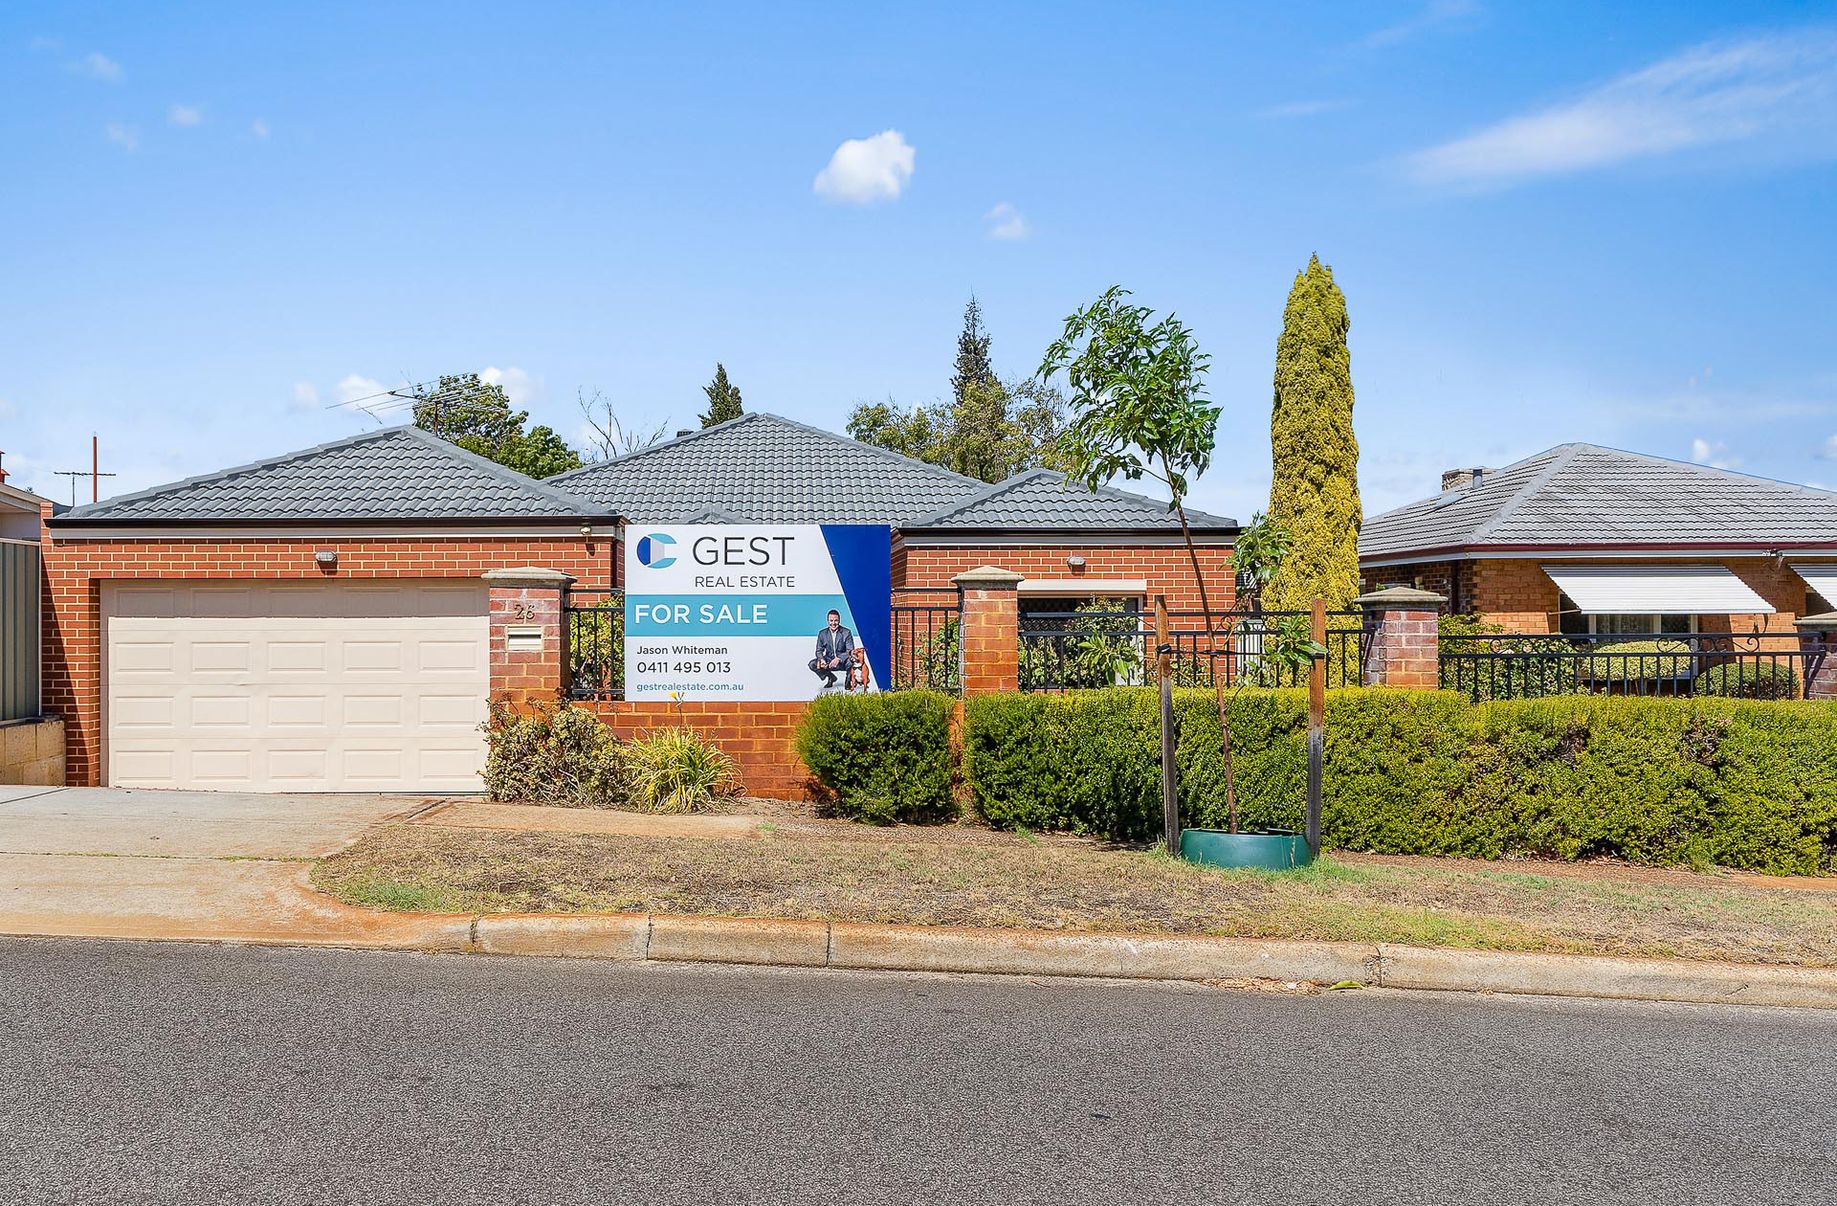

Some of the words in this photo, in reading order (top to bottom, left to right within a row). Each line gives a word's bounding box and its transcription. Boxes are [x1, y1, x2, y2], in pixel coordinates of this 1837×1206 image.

[692, 536, 795, 566] GEST
[694, 575, 735, 588] REAL
[739, 575, 796, 588] ESTATE
[513, 603, 536, 620] 26
[634, 603, 691, 625] FOR
[699, 603, 768, 625] SALE
[636, 645, 669, 656] Jason
[671, 645, 728, 656] Whiteman
[636, 661, 669, 674] 0411
[672, 661, 702, 674] 495
[706, 661, 731, 674] 013
[636, 681, 744, 693] gestrealestate.com.au
